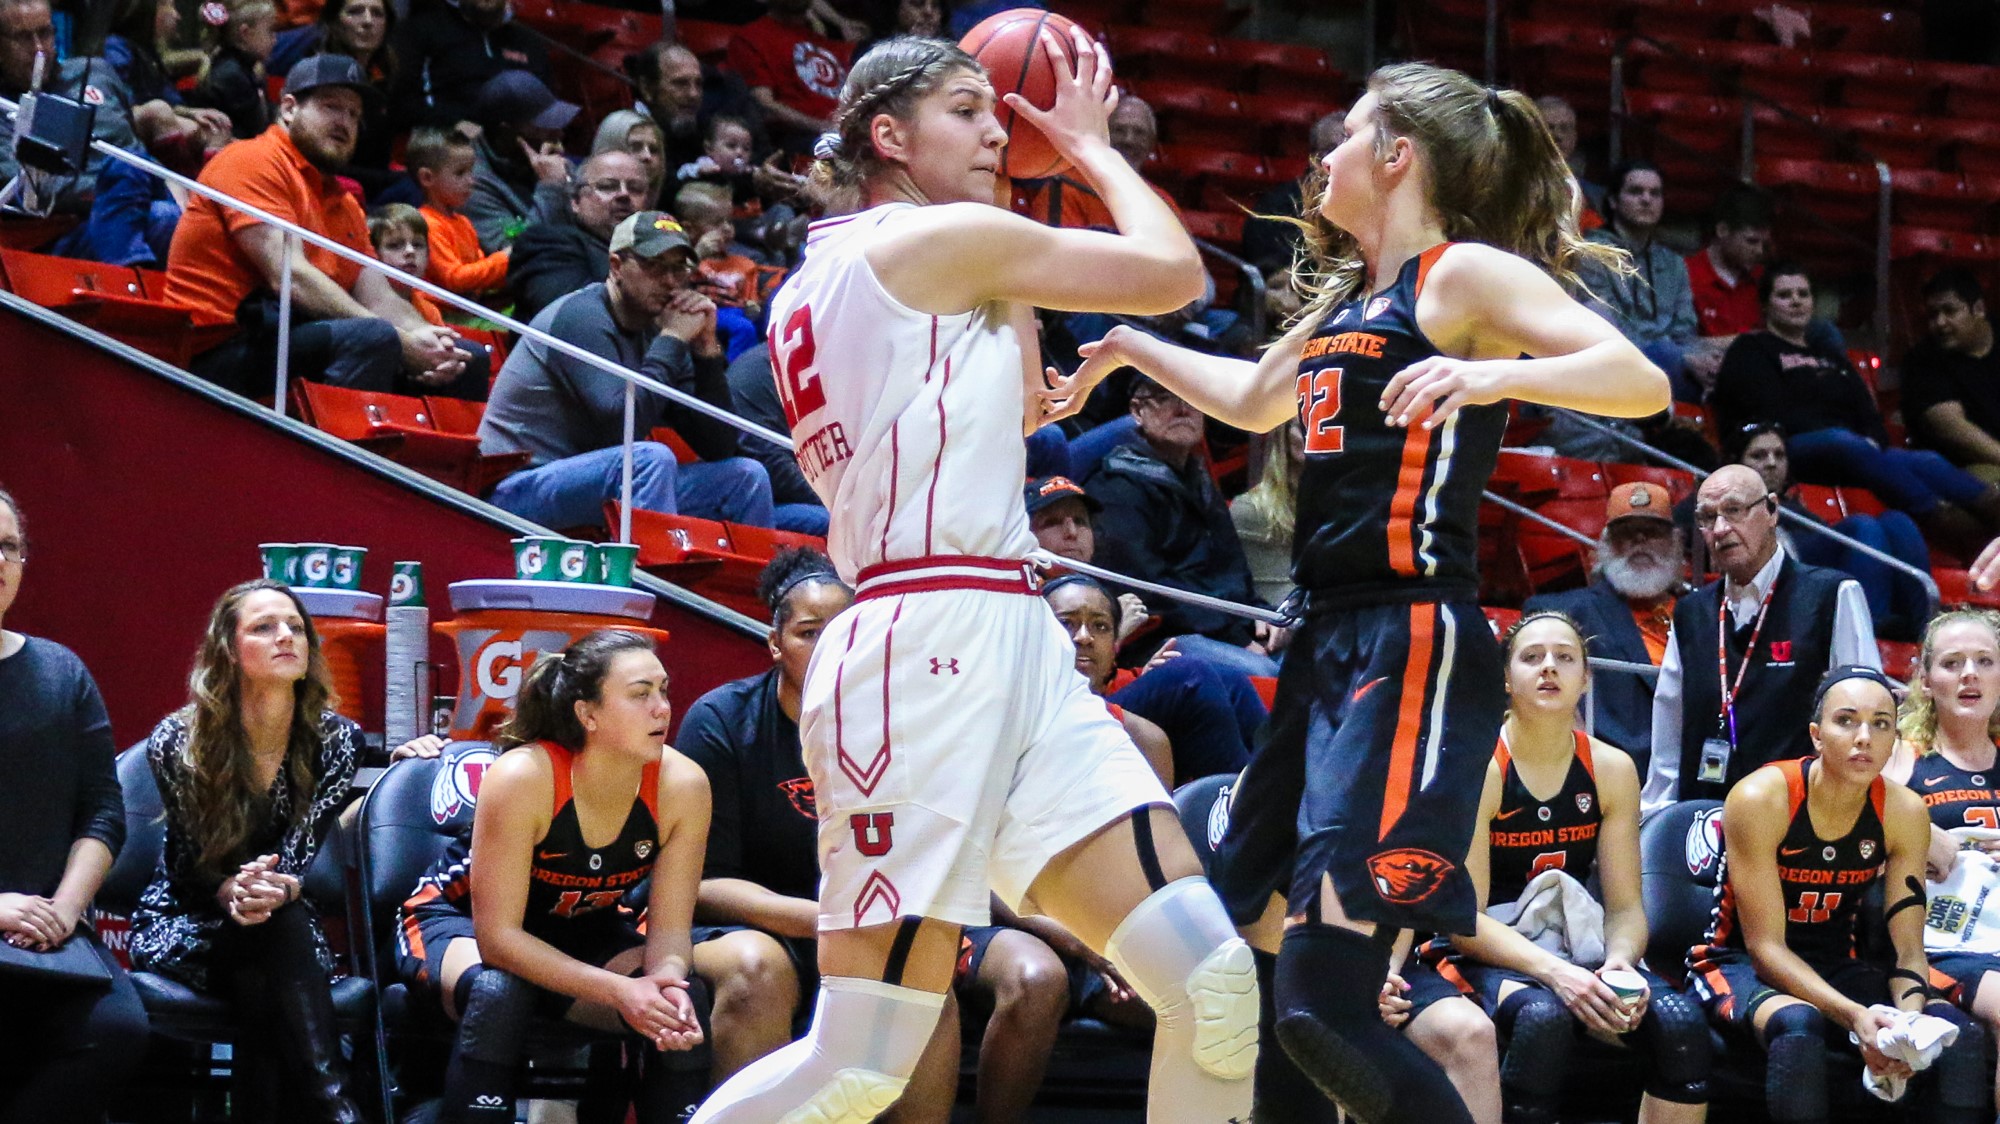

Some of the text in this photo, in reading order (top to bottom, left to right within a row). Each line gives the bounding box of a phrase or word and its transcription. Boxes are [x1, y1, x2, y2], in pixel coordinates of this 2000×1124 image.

[1327, 331, 1388, 359] STATE
[767, 303, 827, 431] 12
[304, 553, 328, 581] G
[332, 556, 353, 585] G
[520, 545, 543, 575] G
[561, 549, 585, 578] G
[1769, 640, 1792, 662] U
[476, 640, 523, 699] G
[1921, 788, 1993, 808] OREGON
[849, 811, 895, 857] U
[1777, 864, 1878, 885] REGON STAT
[1788, 891, 1842, 923] 11
[1924, 895, 1952, 929] CORE
[1943, 901, 1967, 934] POWER
